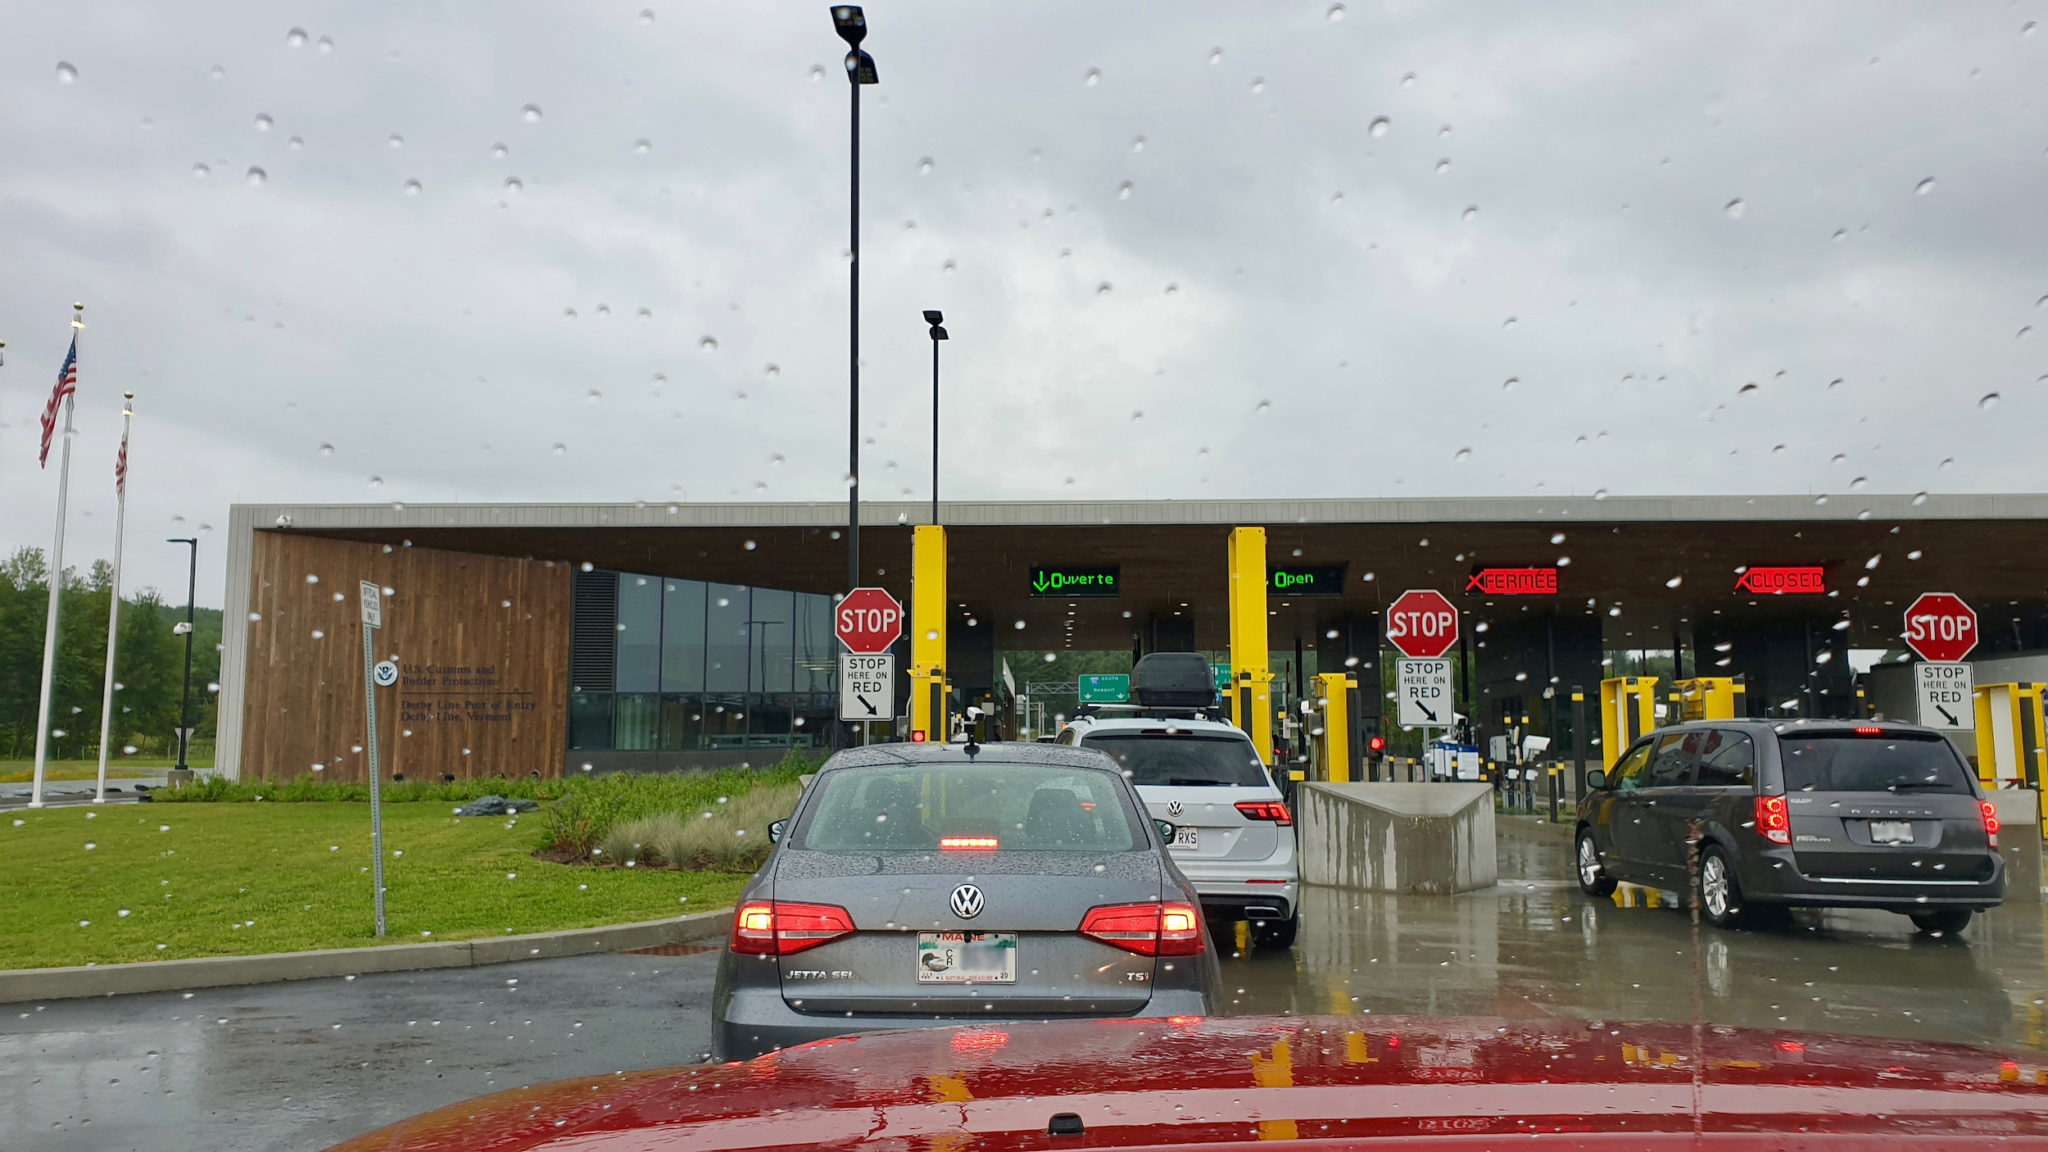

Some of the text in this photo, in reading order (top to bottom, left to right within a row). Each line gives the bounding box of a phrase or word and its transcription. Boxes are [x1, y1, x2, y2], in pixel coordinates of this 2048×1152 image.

[1051, 573, 1113, 588] Ouverte
[1275, 572, 1314, 588] Open
[1485, 570, 1557, 589] FERMÉE
[1752, 573, 1823, 588] CLOSED
[840, 608, 897, 633] STOP
[1394, 611, 1453, 637] STOP
[1911, 615, 1972, 641] STOP
[476, 664, 496, 674] and
[849, 658, 886, 669] STOP
[1405, 663, 1444, 674] STOP
[848, 671, 887, 680] HERE ON
[1924, 667, 1964, 679] STOP
[402, 676, 496, 686] Border Protection
[1404, 676, 1446, 685] HERE ON
[1923, 681, 1967, 690] HERE ON
[852, 681, 882, 693] RED
[1410, 687, 1440, 699] RED
[1929, 691, 1961, 703] RED
[402, 700, 537, 712] Derby Line Port of Entry
[466, 711, 513, 721] Vermont
[1178, 832, 1197, 844] RXS
[942, 933, 985, 941] MANE
[785, 970, 827, 979] JETTA
